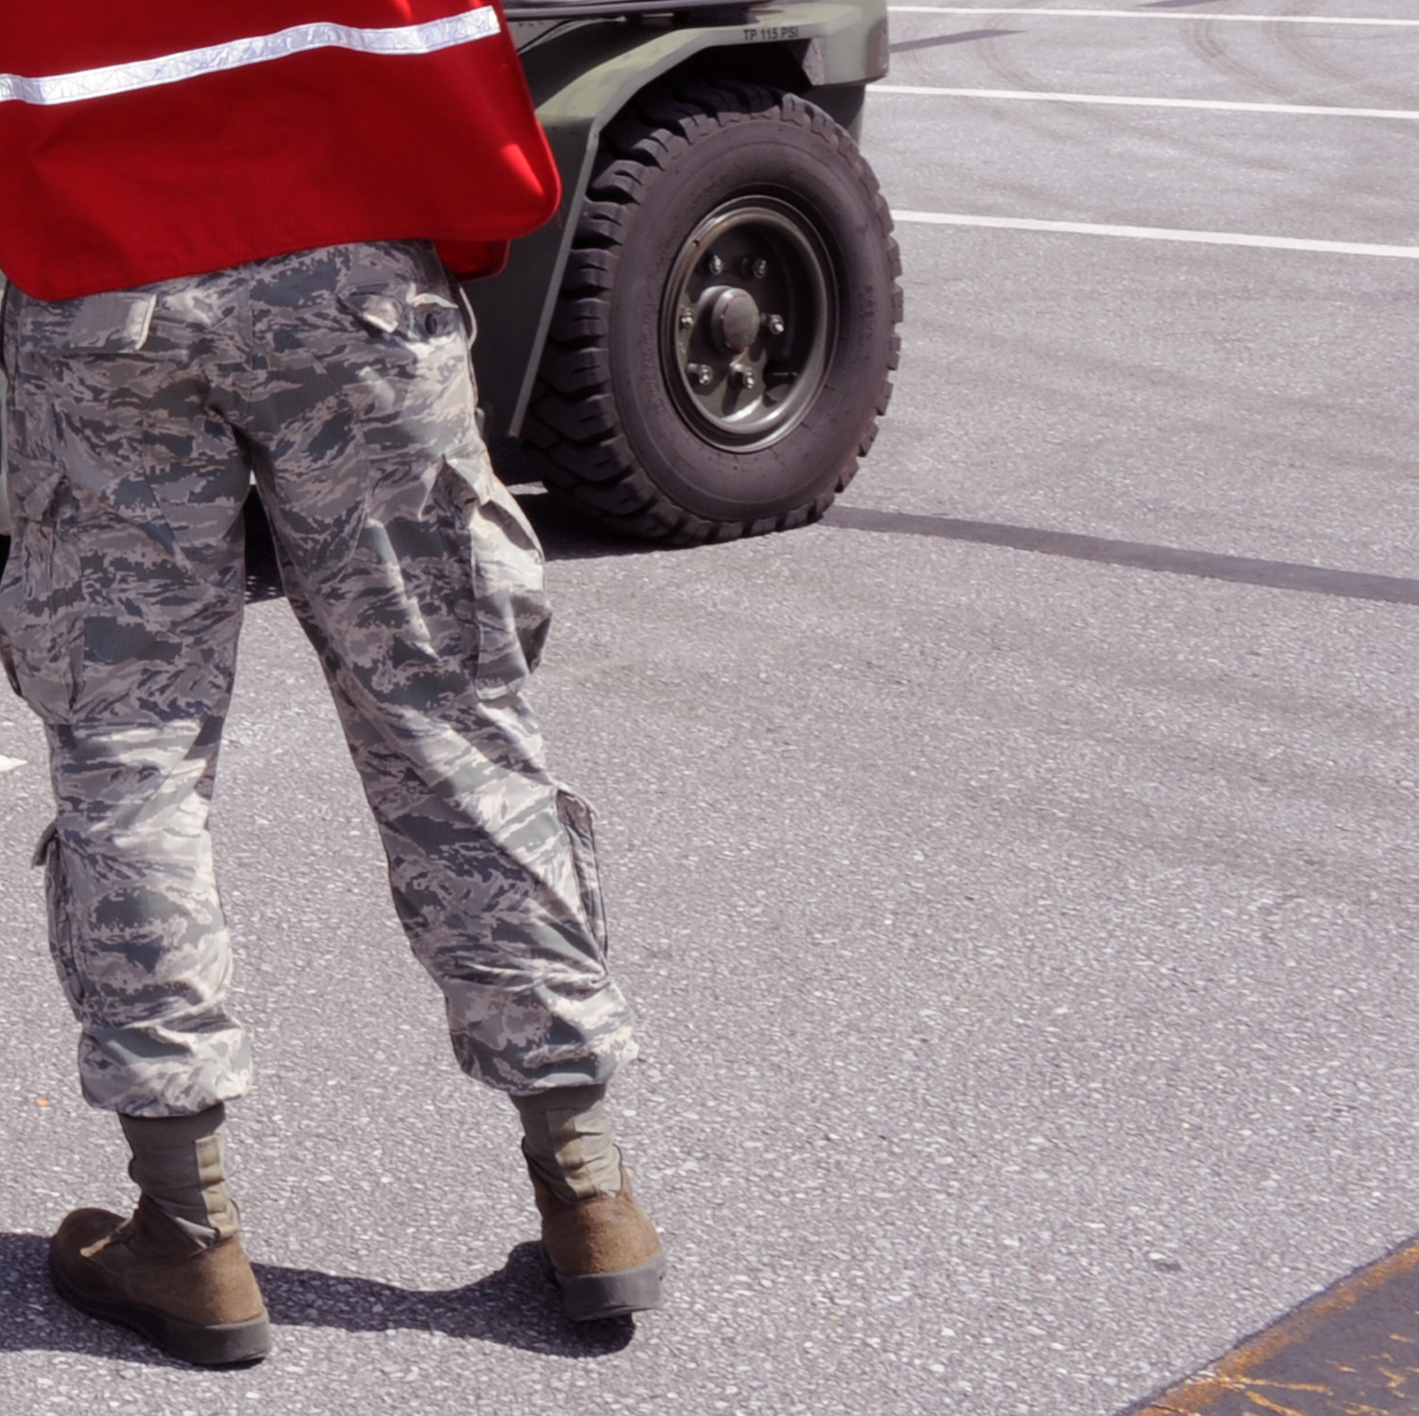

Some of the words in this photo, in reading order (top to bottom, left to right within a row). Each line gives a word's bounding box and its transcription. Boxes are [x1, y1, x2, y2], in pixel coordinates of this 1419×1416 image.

[743, 29, 757, 41] TP
[761, 28, 777, 40] 115
[780, 26, 799, 39] PSI
